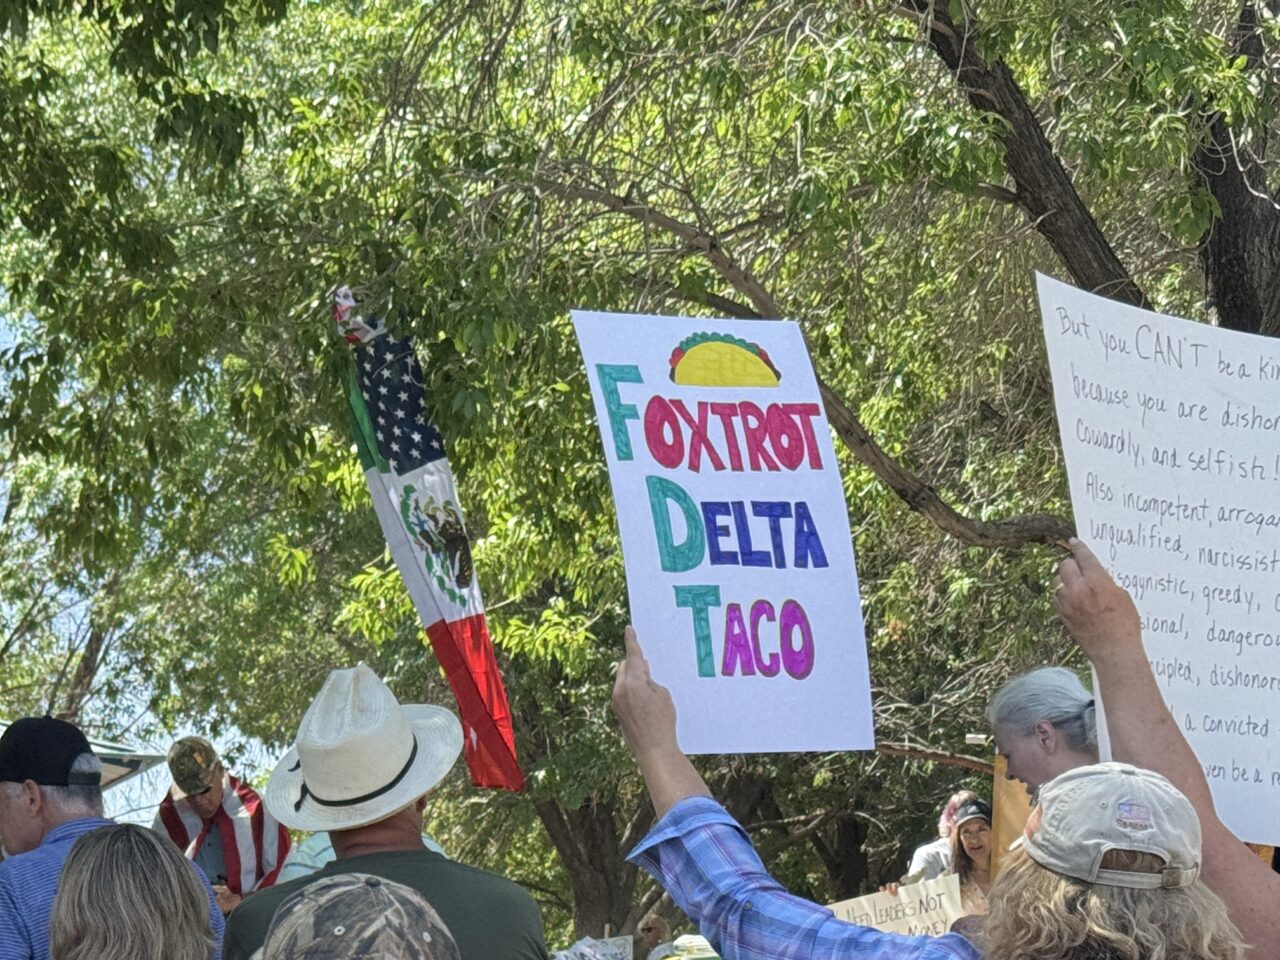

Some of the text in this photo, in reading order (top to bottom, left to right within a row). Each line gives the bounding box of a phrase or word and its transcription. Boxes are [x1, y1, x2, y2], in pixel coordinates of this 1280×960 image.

[1056, 306, 1090, 340] But
[1099, 329, 1130, 361] you
[1135, 324, 1208, 369] CAN'T
[1218, 350, 1234, 377] be
[1238, 364, 1251, 378] a
[595, 363, 824, 473] FOXTROT
[1070, 362, 1129, 408] because
[1137, 392, 1167, 428] you
[1177, 403, 1208, 421] are
[1076, 418, 1145, 468] Cowardly,
[1151, 448, 1181, 468] and
[645, 474, 830, 573] DELTA
[1086, 471, 1280, 536] Also incompetent, arroga
[1089, 519, 1189, 561] unqualified,
[1108, 565, 1194, 601] sogynistic,
[1202, 584, 1261, 615] greedy,
[672, 585, 816, 681] TACO
[1185, 713, 1270, 738] a convicted
[1231, 759, 1249, 783] be
[1253, 768, 1263, 783] a
[919, 892, 946, 914] NOT
